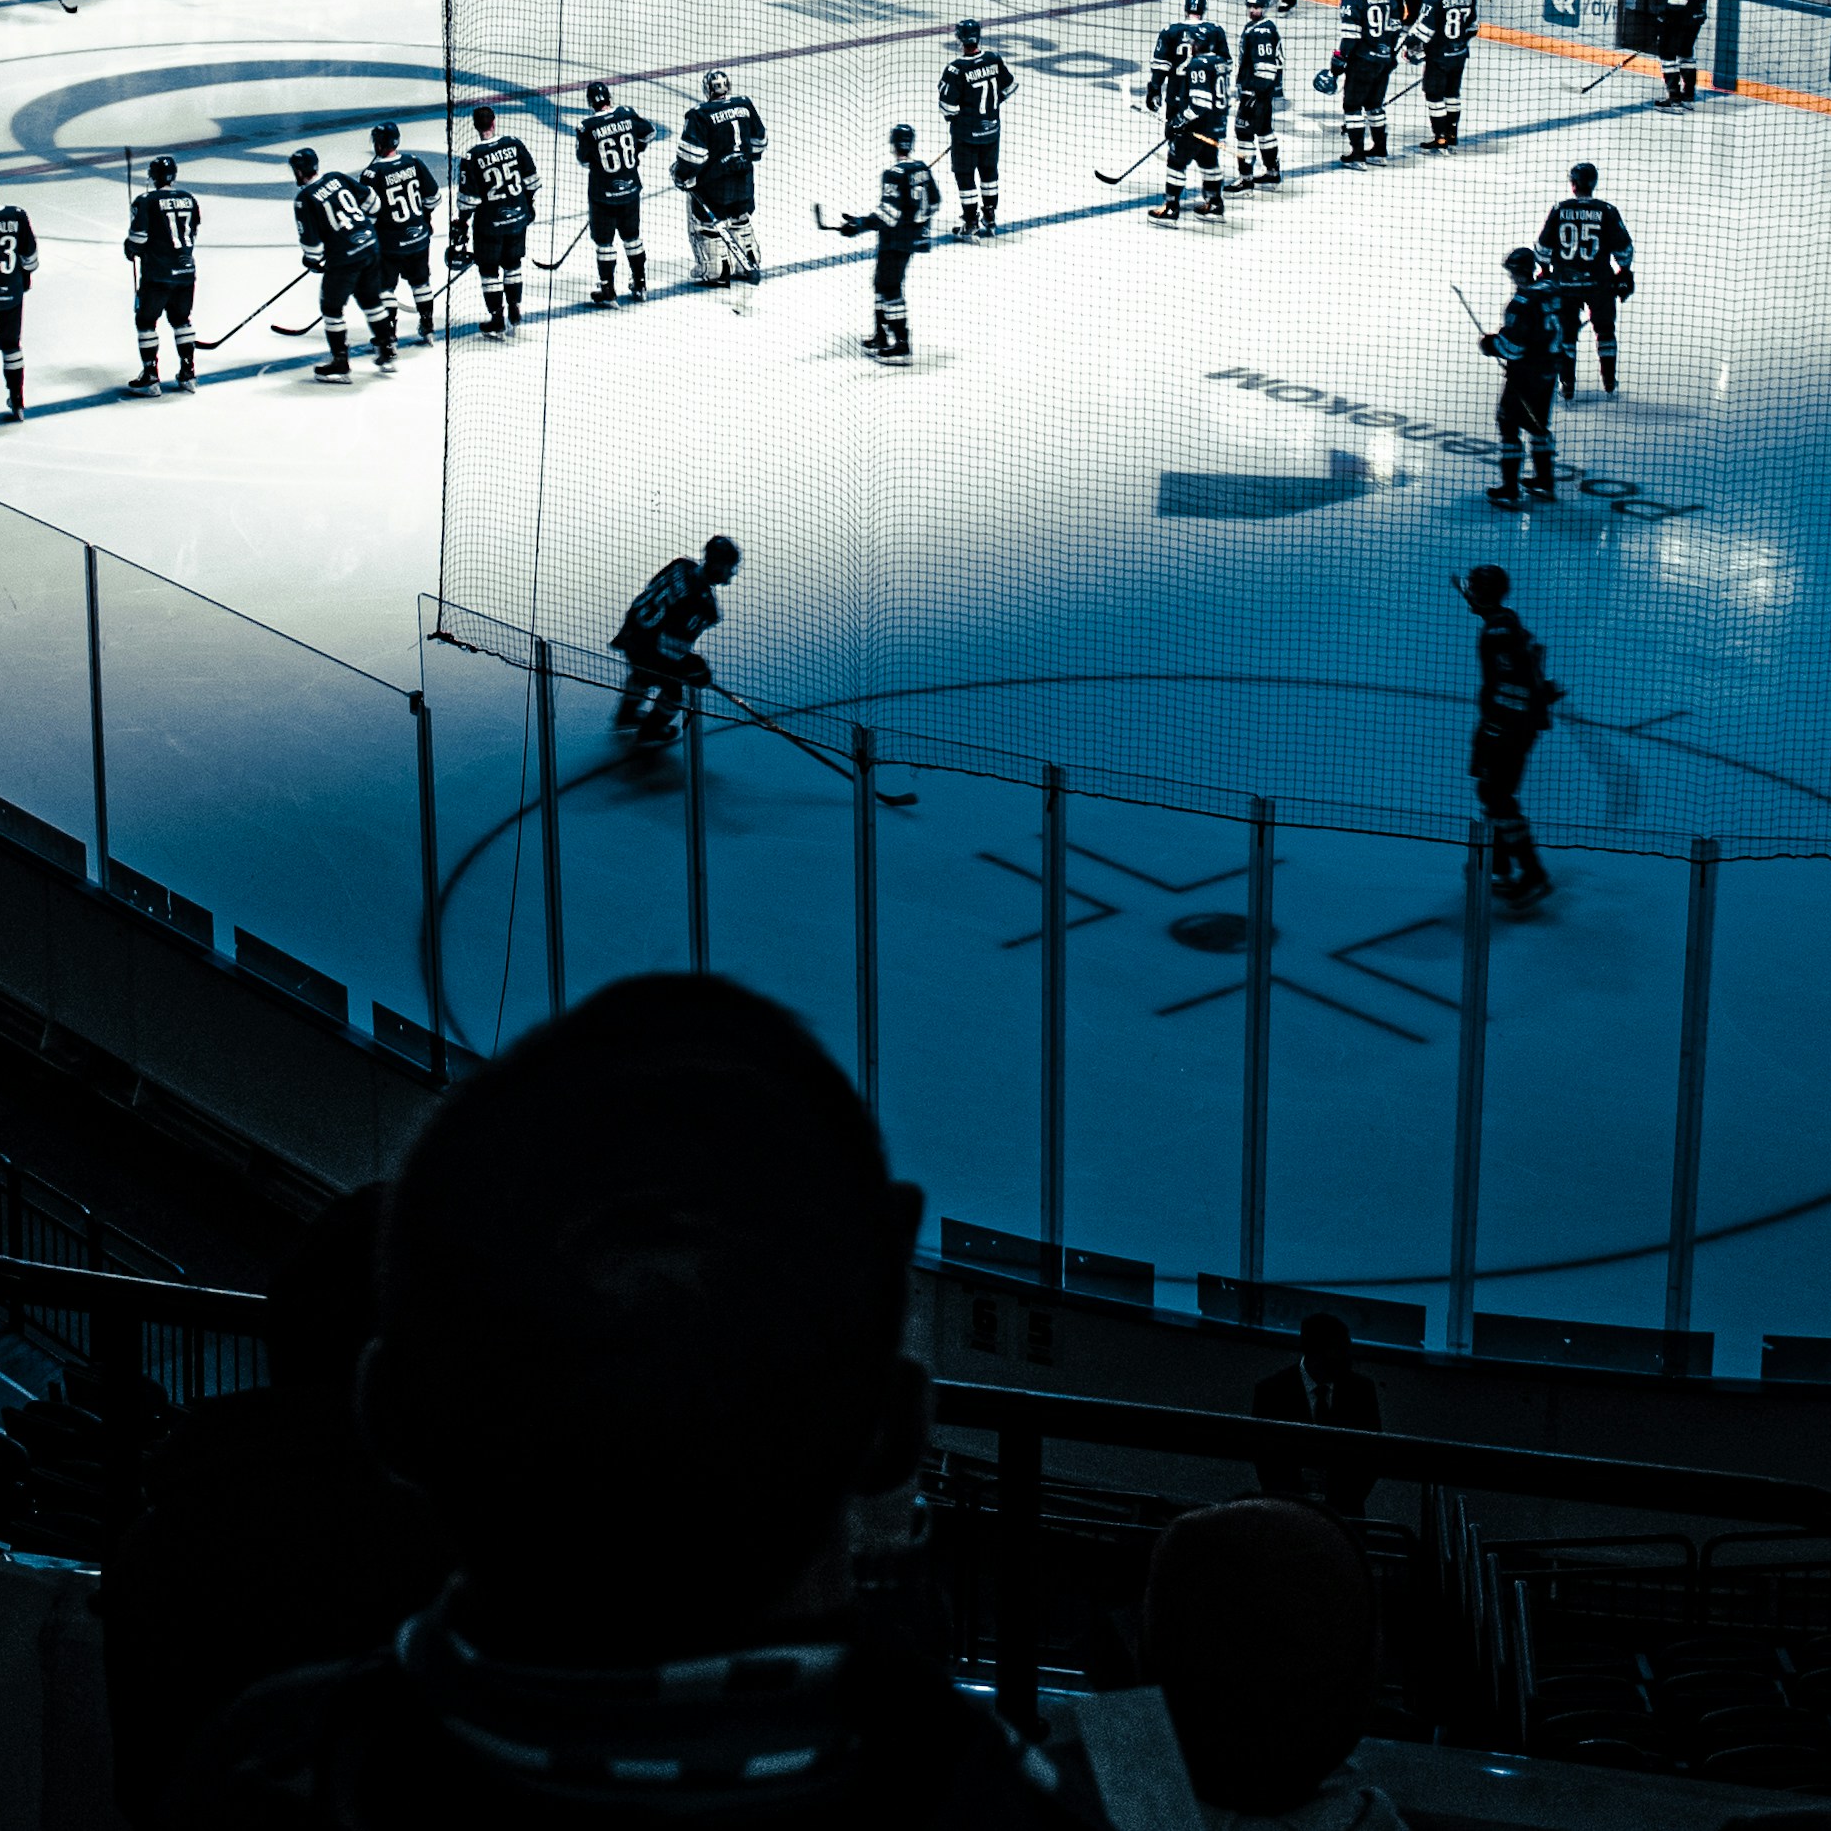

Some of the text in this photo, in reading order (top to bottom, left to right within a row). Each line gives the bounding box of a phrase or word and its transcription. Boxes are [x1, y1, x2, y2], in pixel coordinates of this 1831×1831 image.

[1446, 7, 1471, 40] 87
[1257, 43, 1274, 58] 86
[971, 77, 1000, 116] 71
[1189, 69, 1207, 85] 99
[598, 133, 636, 174] 68
[731, 120, 742, 153] 1
[483, 160, 523, 202] 25
[321, 193, 364, 235] 49
[385, 180, 424, 224] 56
[1558, 209, 1603, 224] KULYOMIN
[166, 211, 193, 250] 17
[1558, 221, 1601, 261] 95
